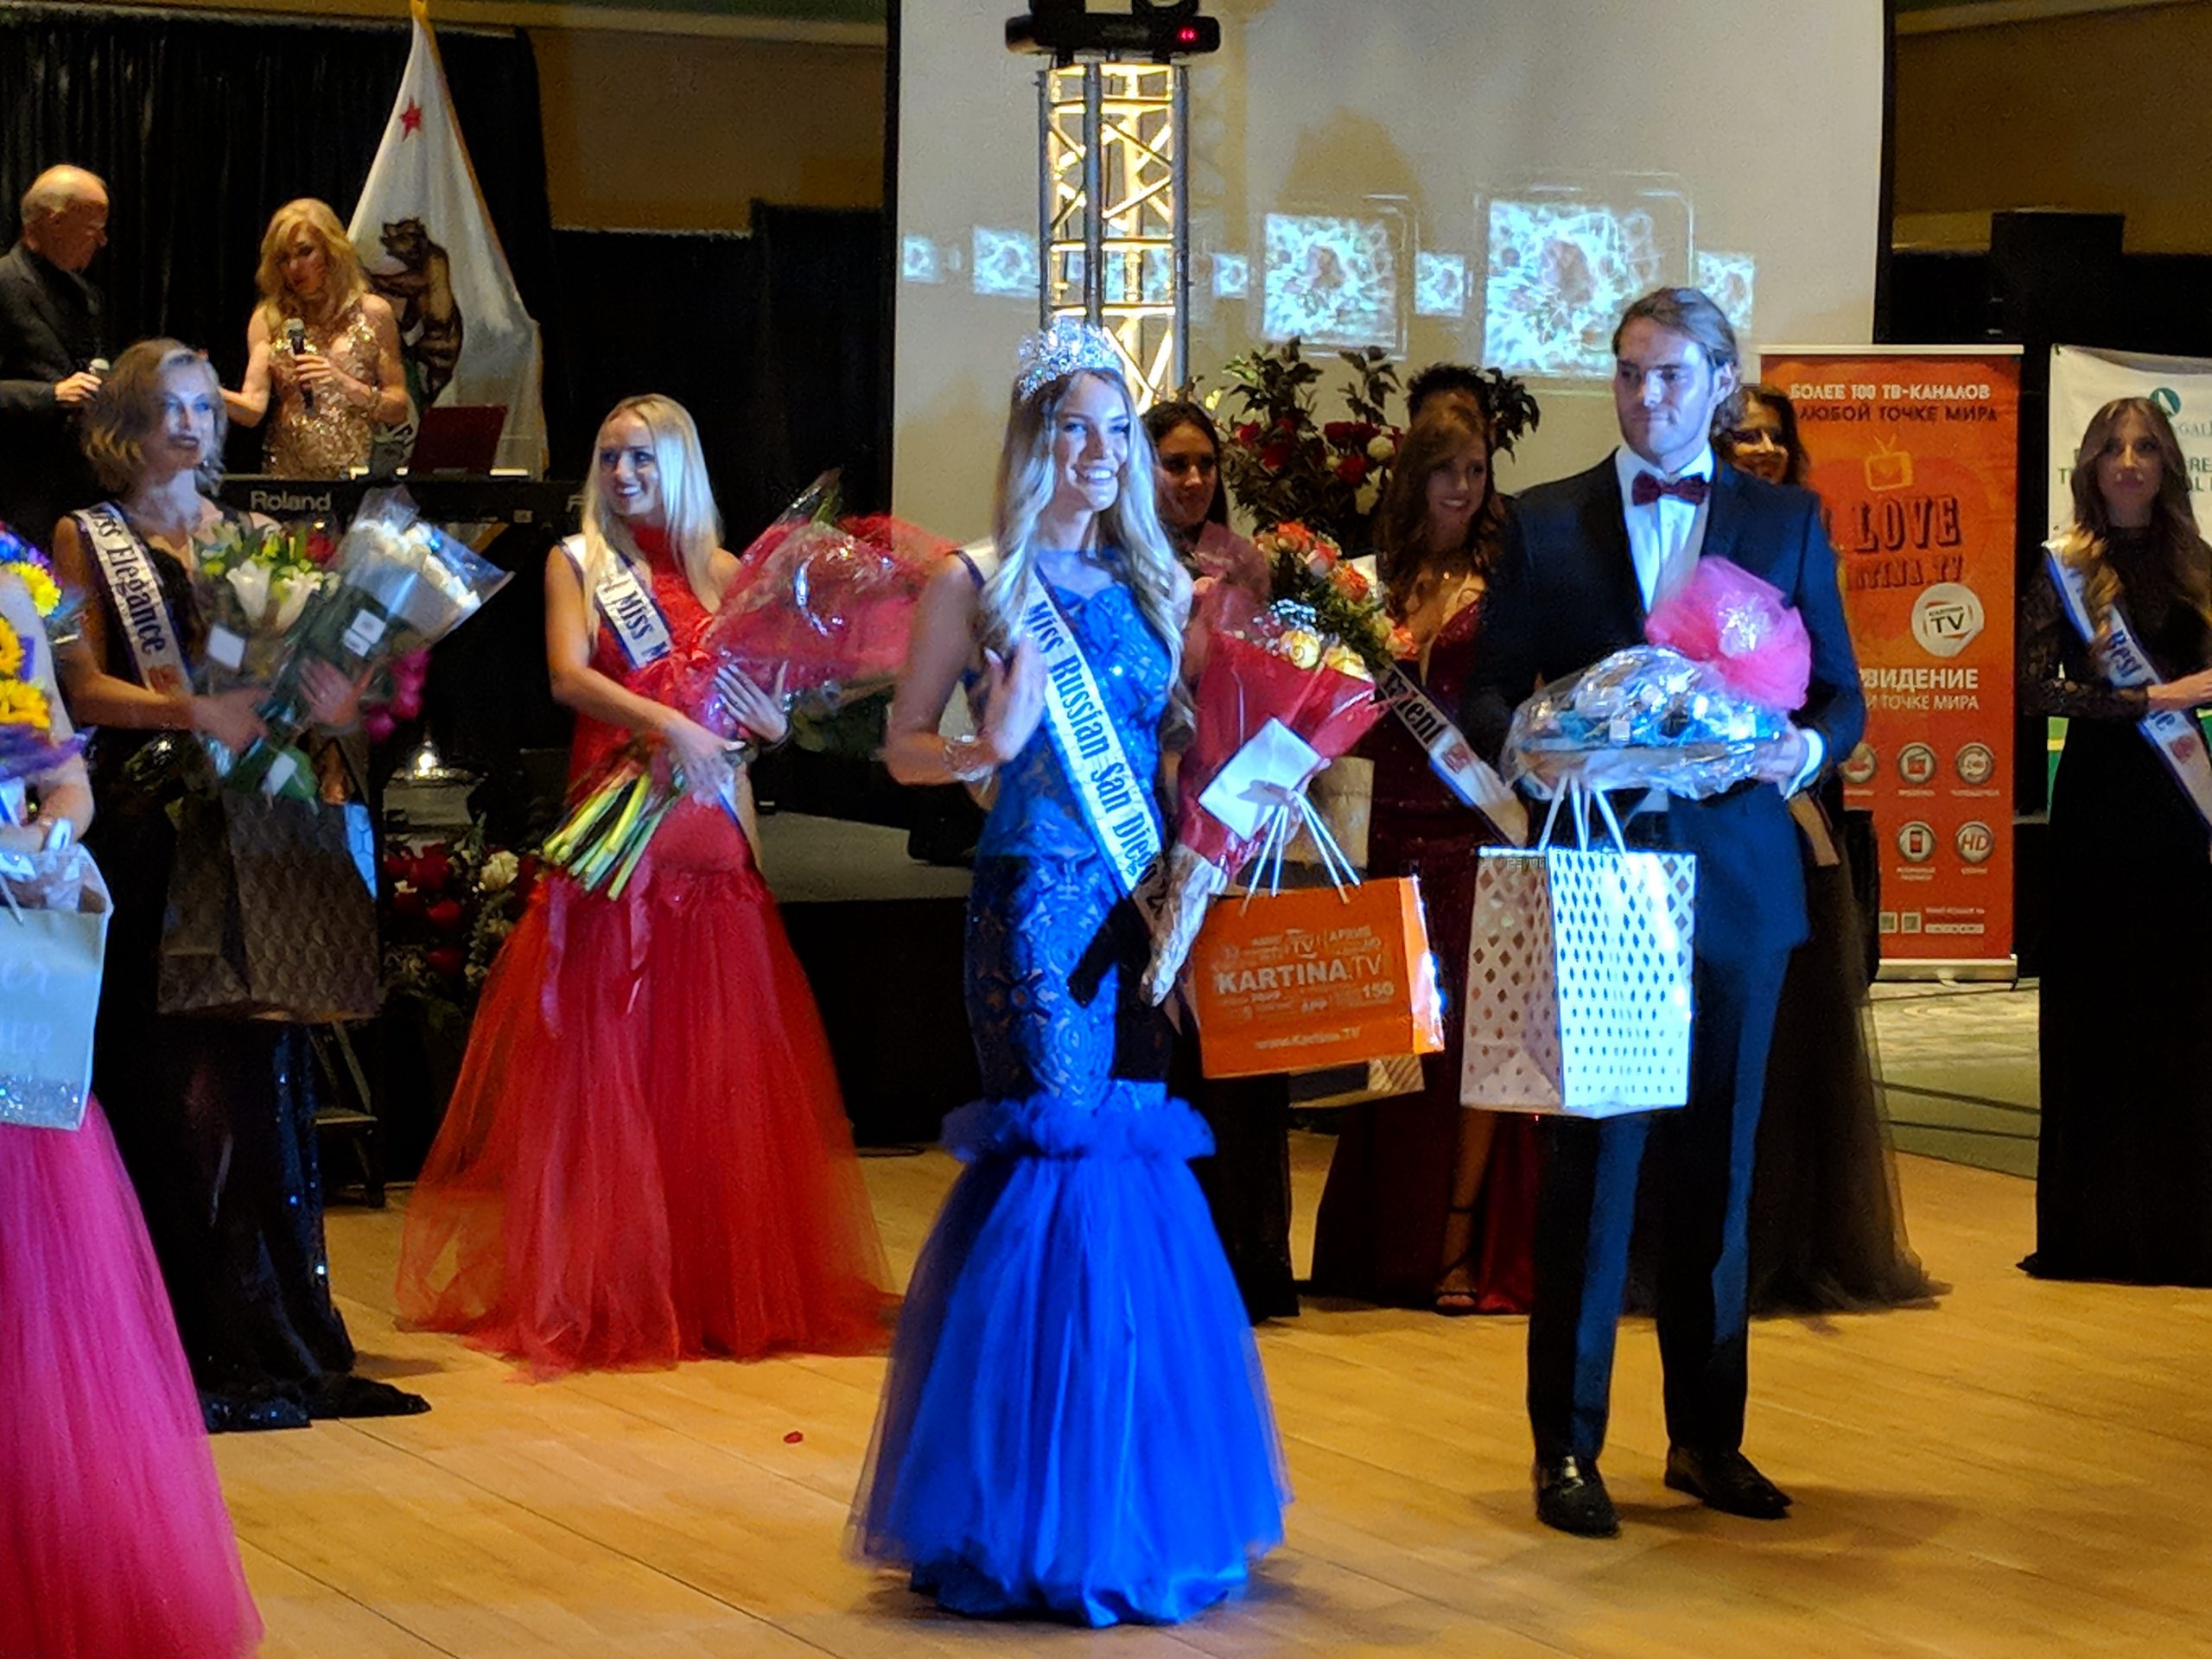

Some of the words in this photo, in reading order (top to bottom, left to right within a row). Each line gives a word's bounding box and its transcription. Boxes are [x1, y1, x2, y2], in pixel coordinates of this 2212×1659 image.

[1789, 384, 1846, 400] БОЛЕЕ
[1881, 383, 1991, 400] ТВ-КАНАЛОВ
[1880, 404, 1937, 422] ТОЧКЕ
[1945, 404, 1998, 422] МИРА
[250, 490, 332, 512] Roland
[1853, 495, 1963, 554] LOVE
[107, 544, 166, 656] Elegance
[1930, 613, 1965, 633] TV
[1859, 668, 1979, 692] ВИДЕНИЕ
[1027, 600, 1065, 654] Miss
[1050, 654, 1110, 760] Russian
[1091, 762, 1133, 813] San
[1880, 695, 1929, 710] ТОЧКЕ
[1934, 695, 1980, 710] МИРА
[1961, 833, 1988, 852] HD
